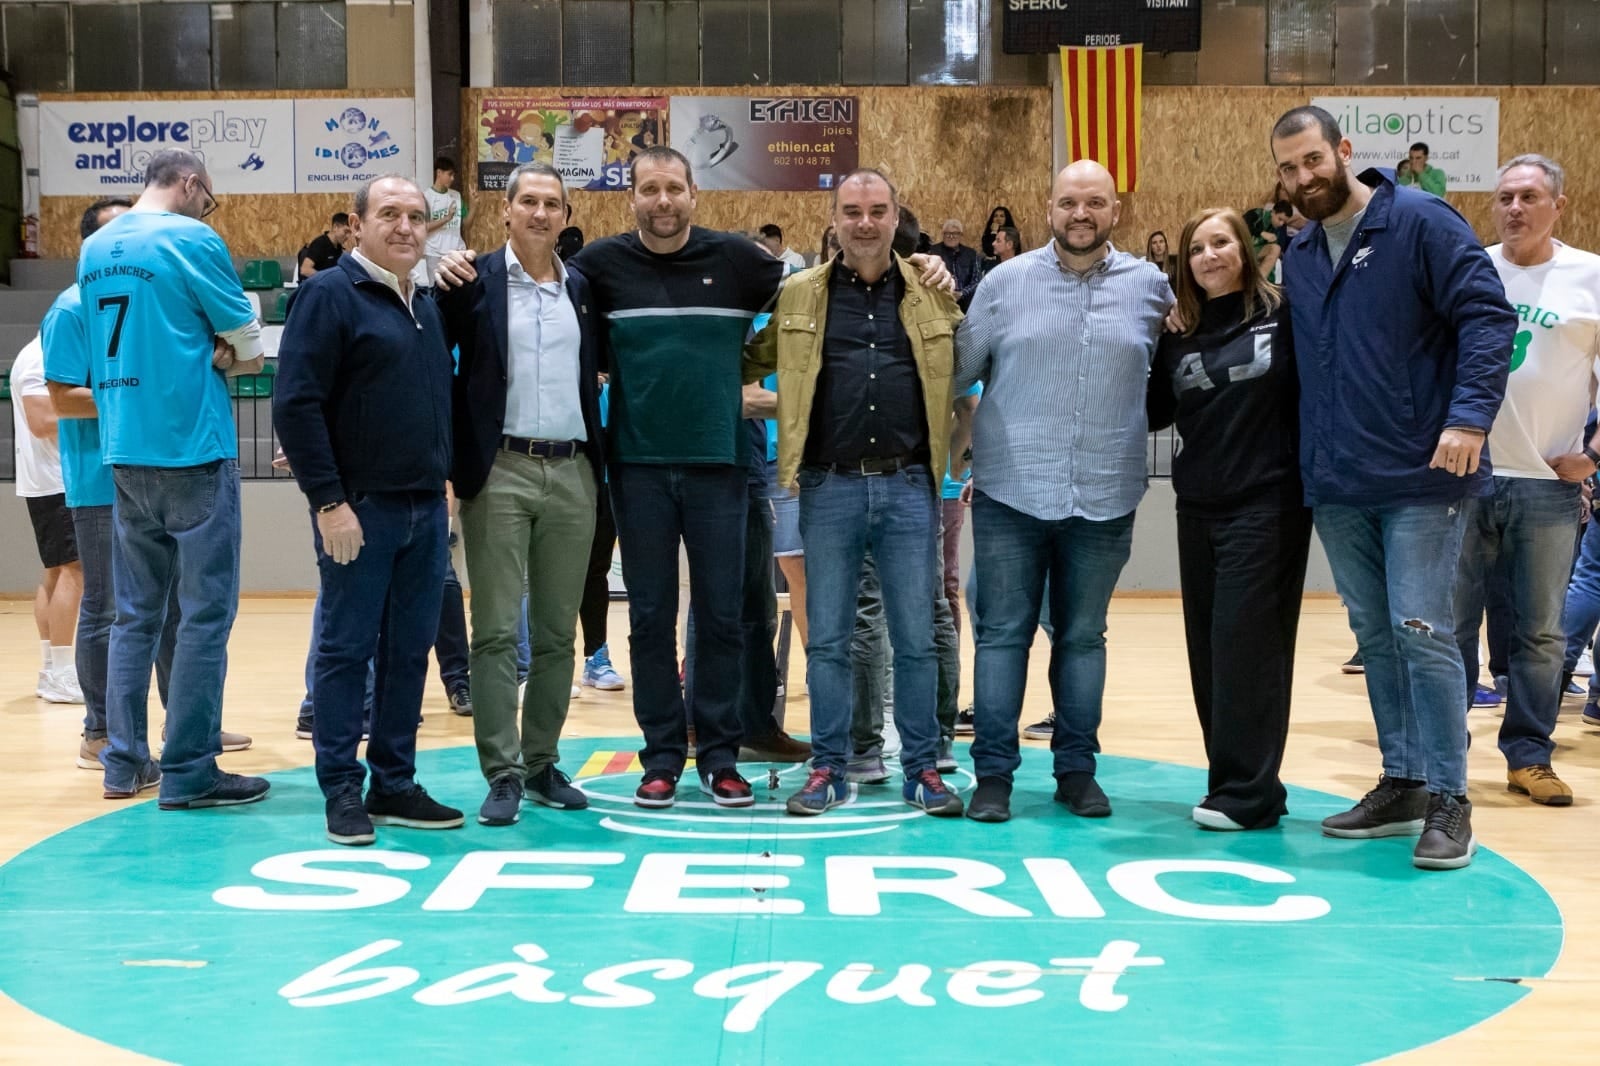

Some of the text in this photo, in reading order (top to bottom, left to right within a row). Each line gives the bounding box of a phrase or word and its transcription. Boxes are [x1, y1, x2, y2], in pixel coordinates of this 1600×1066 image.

[1009, 0, 1068, 10] SFERIC
[1146, 0, 1188, 8] VISITANT
[1085, 34, 1121, 45] PERIODE
[749, 98, 853, 123] ETHIEN
[823, 126, 853, 137] joies
[768, 142, 836, 152] ethien.cat
[75, 149, 122, 170] and
[774, 157, 831, 165] 602 10 48 76
[307, 174, 349, 182] ENGLISH
[555, 168, 595, 177] MAGINA
[1466, 174, 1481, 183] 136
[104, 264, 155, 283] SÁNCHEZ
[97, 292, 132, 361] 7
[212, 849, 1332, 921] SFERIC
[278, 939, 1164, 1033] bàsquet
